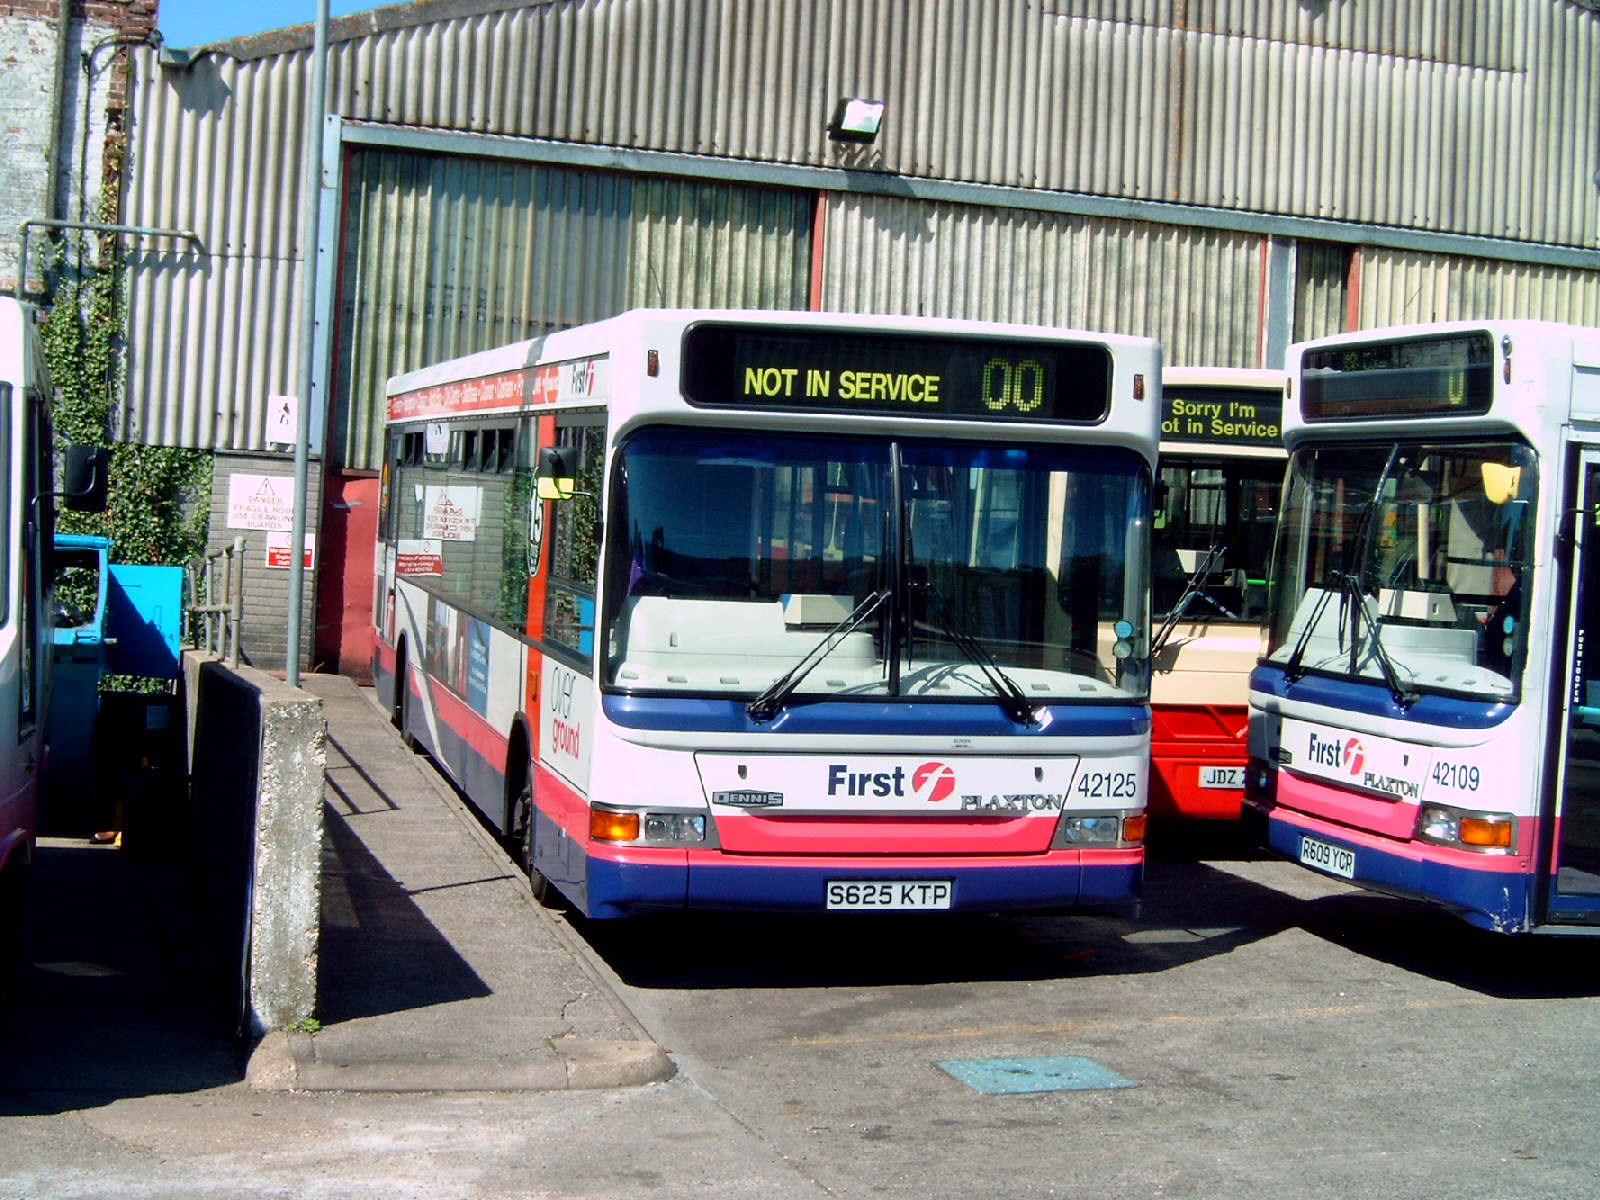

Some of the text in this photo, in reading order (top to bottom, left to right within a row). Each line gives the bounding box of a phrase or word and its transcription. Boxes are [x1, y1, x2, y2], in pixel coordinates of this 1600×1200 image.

[744, 367, 940, 403] NOT IN SERVICE
[981, 357, 1045, 413] 00
[1172, 399, 1256, 419] Sorry I'm
[1161, 418, 1278, 437] ot in Service
[248, 495, 283, 504] DANGER
[552, 718, 580, 759] ground
[1308, 733, 1341, 767] First
[828, 765, 905, 797] First
[1078, 772, 1136, 798] 42125
[1206, 769, 1236, 784] JDZ
[1364, 772, 1419, 798] PLAXTON
[1432, 761, 1480, 791] 42109
[712, 791, 783, 806] DENNIS
[961, 794, 1063, 810] PLAXTON
[1302, 840, 1354, 873] R609 YCR
[829, 884, 947, 906] S625 KTP
